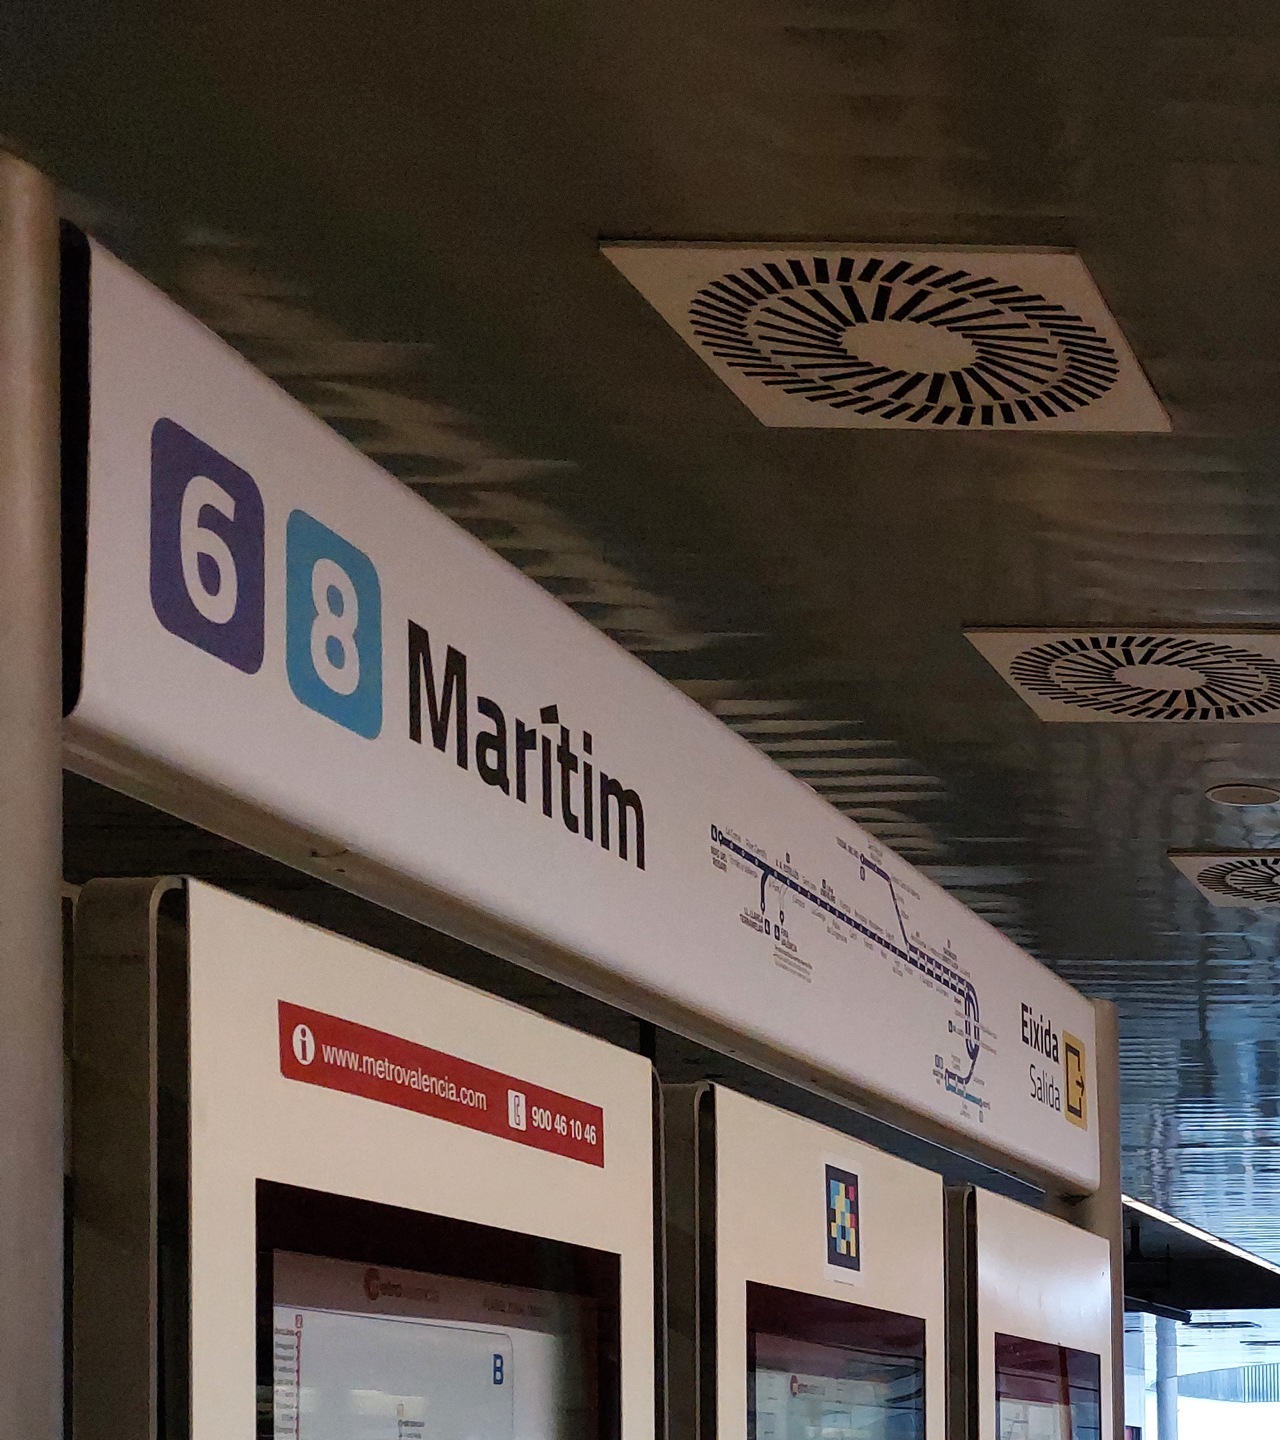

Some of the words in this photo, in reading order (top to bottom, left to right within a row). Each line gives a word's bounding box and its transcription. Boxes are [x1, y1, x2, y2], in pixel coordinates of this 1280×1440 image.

[180, 476, 238, 624] 6
[311, 557, 359, 697] 8
[407, 619, 645, 872] Marítim
[1021, 1002, 1060, 1065] Eixida
[321, 1043, 488, 1111] www.metrovalencia.com
[1029, 1063, 1061, 1112] Salida
[531, 1105, 552, 1131] 900
[553, 1112, 568, 1136] 46
[570, 1118, 582, 1141] 10
[583, 1123, 597, 1145] 46
[493, 1354, 503, 1385] B
